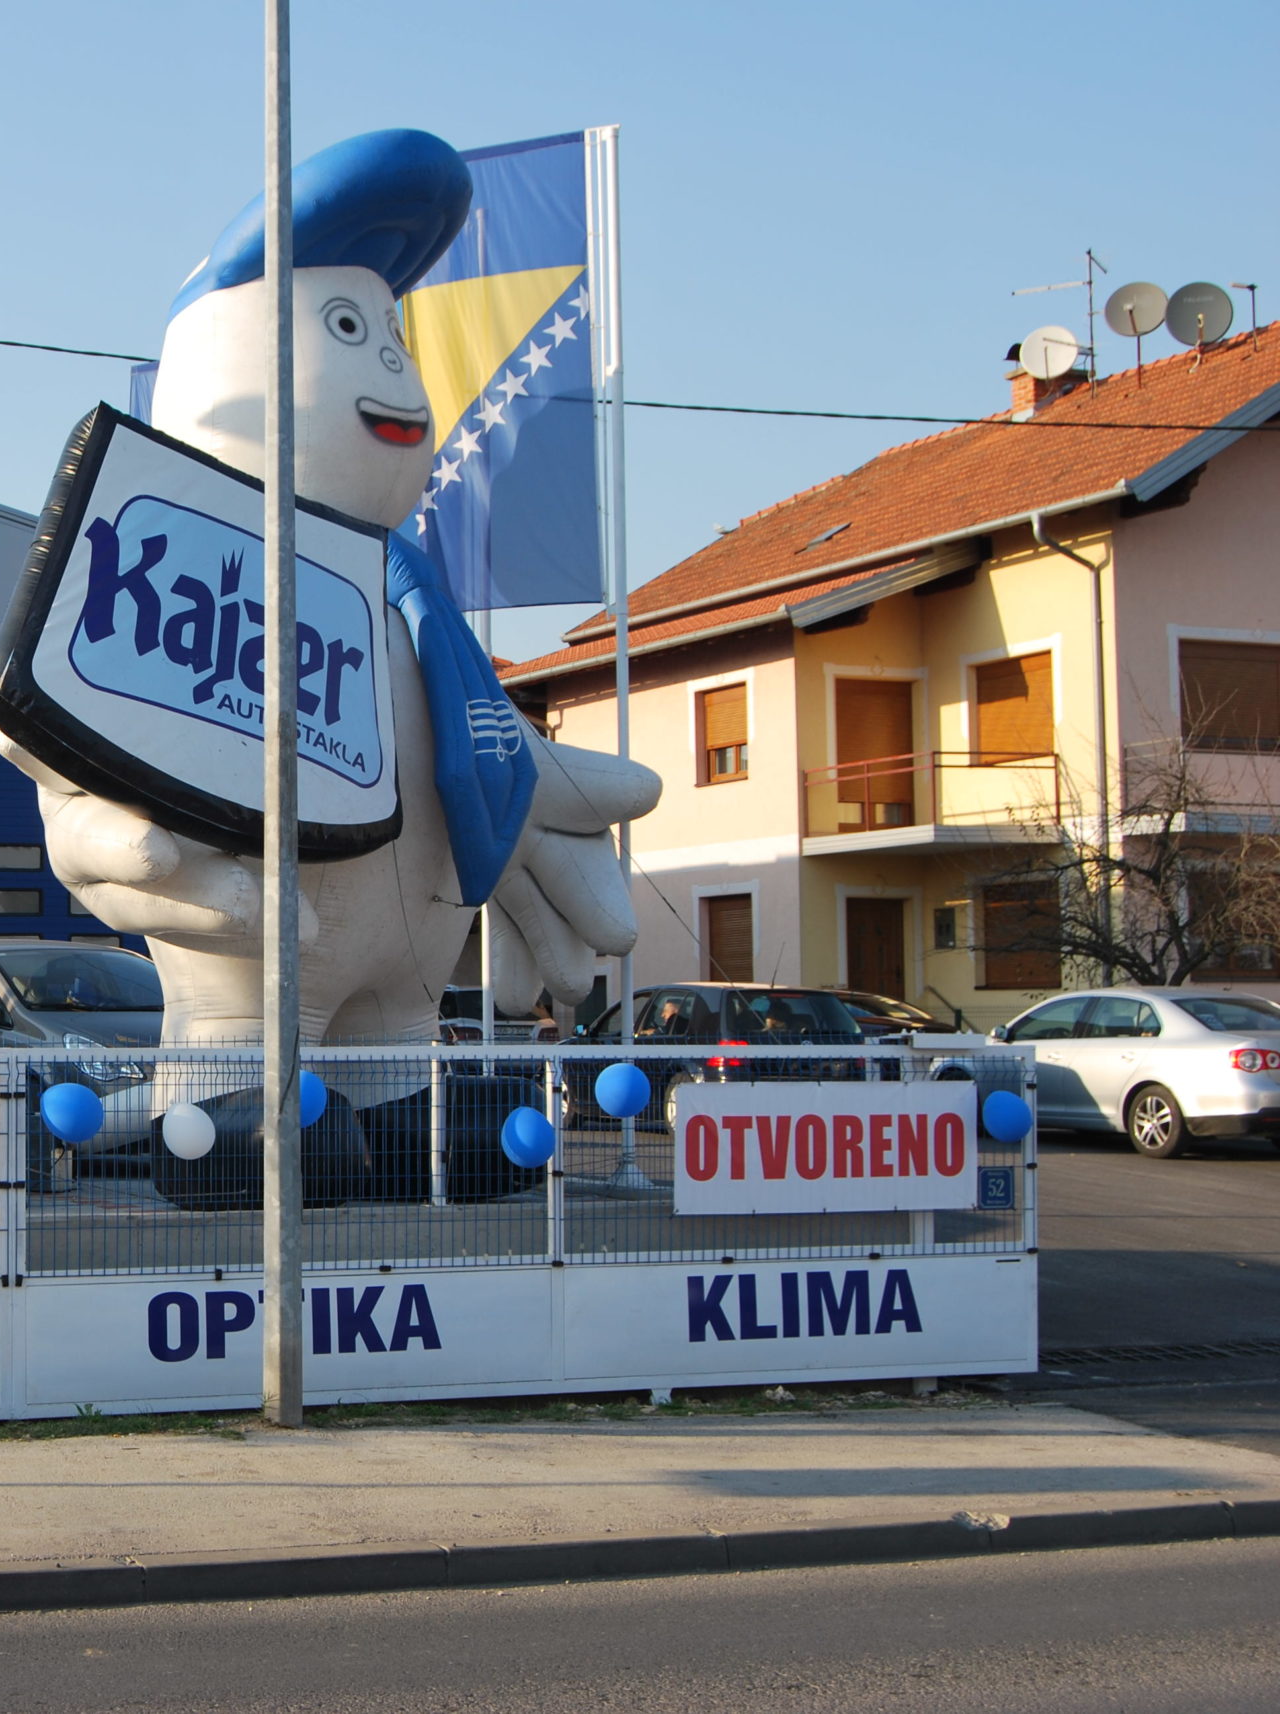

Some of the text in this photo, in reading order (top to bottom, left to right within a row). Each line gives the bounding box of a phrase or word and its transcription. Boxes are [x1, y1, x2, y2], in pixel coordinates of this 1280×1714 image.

[217, 693, 366, 773] AUTTAKLA
[685, 1112, 965, 1182] OTVORENO
[988, 1178, 1005, 1197] 52
[147, 1283, 442, 1363] OPIKA
[687, 1268, 923, 1343] KLIMA
